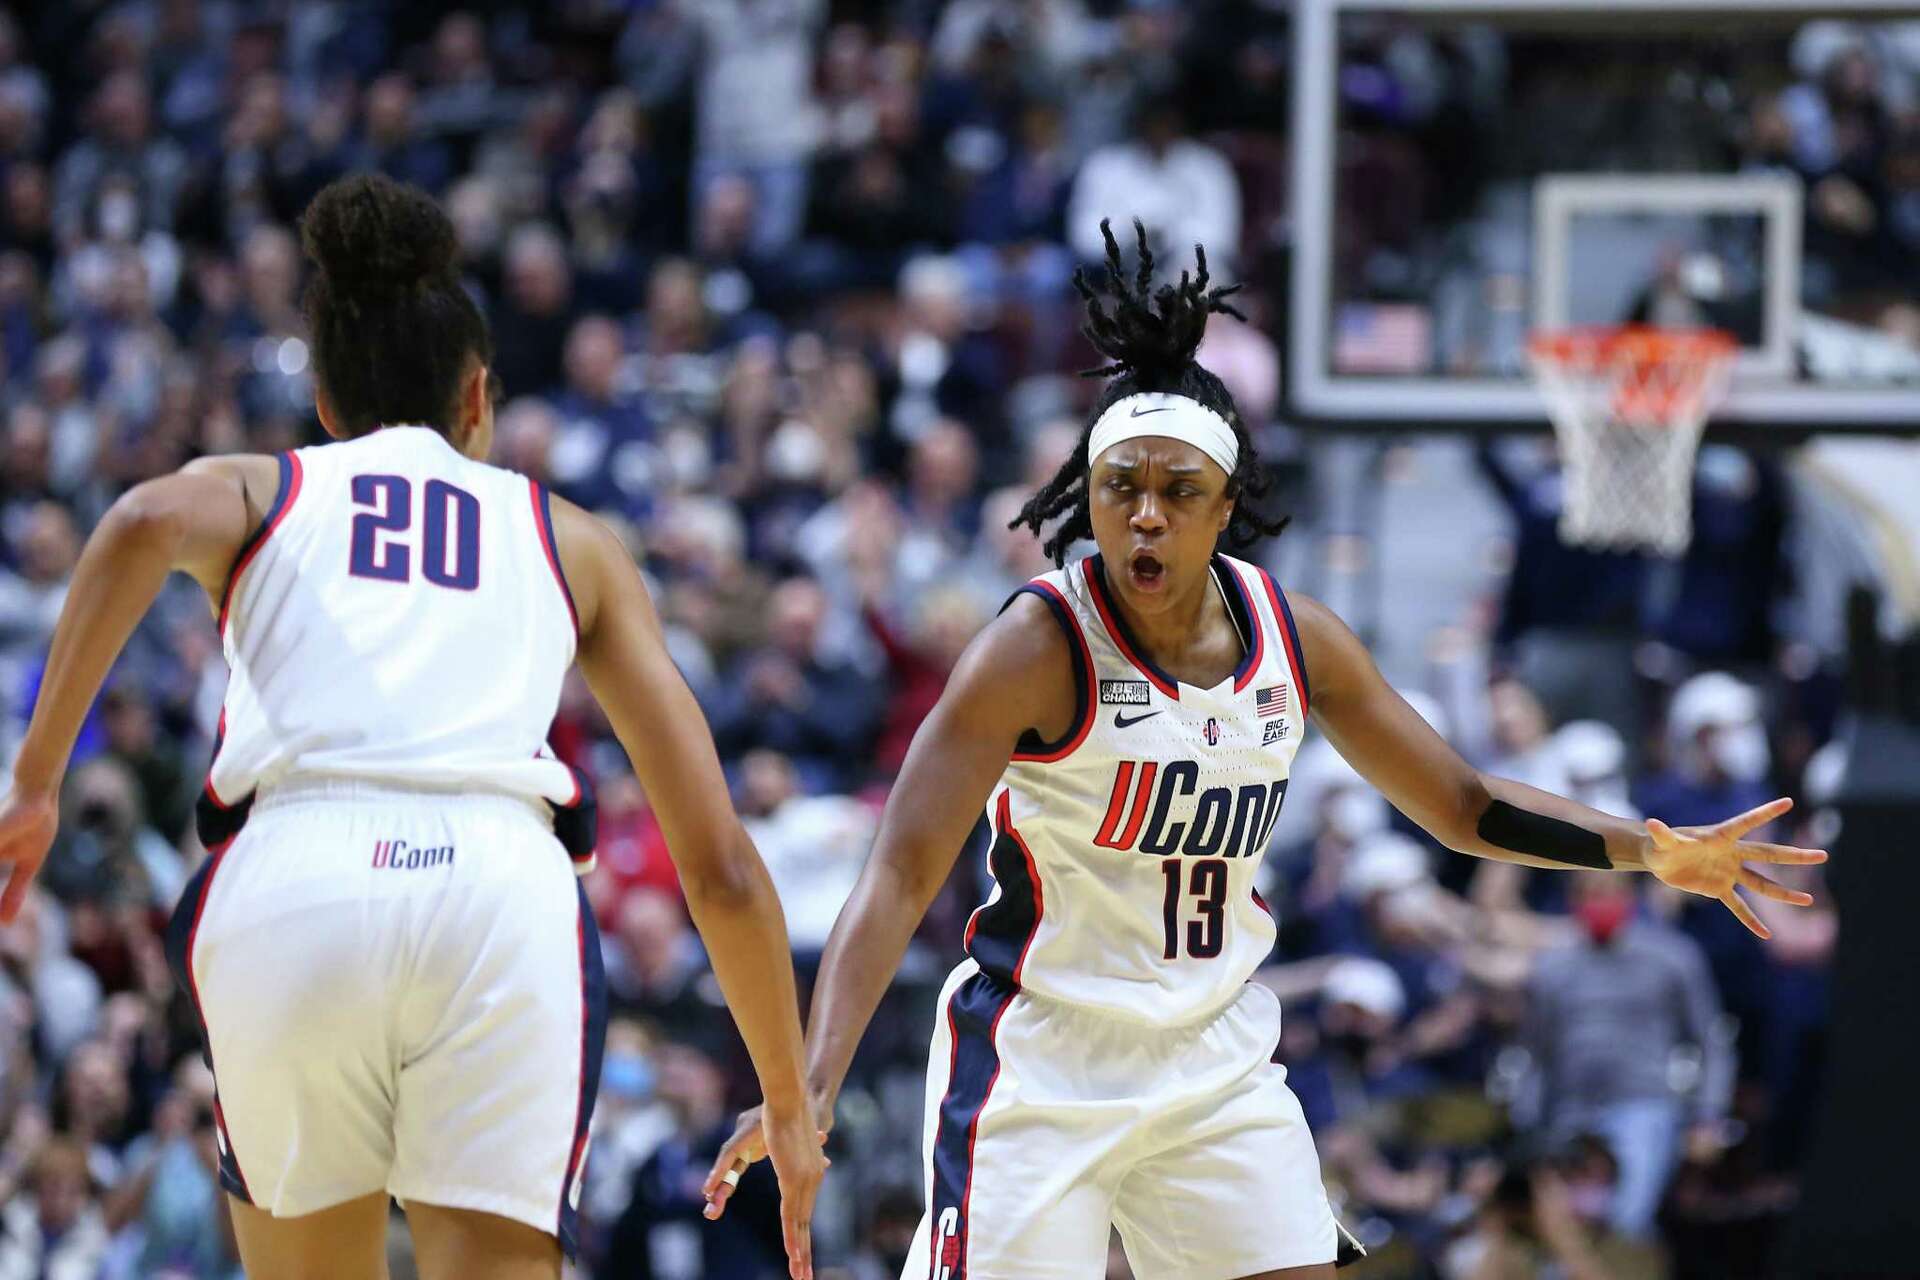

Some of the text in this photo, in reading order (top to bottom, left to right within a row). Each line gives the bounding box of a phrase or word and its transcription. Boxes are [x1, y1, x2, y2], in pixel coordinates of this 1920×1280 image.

[349, 474, 480, 591] 20
[1102, 693, 1148, 703] CHANGE
[1262, 726, 1290, 742] EAST
[1264, 718, 1285, 732] BIG
[370, 839, 455, 870] UConn
[1161, 858, 1229, 960] 13
